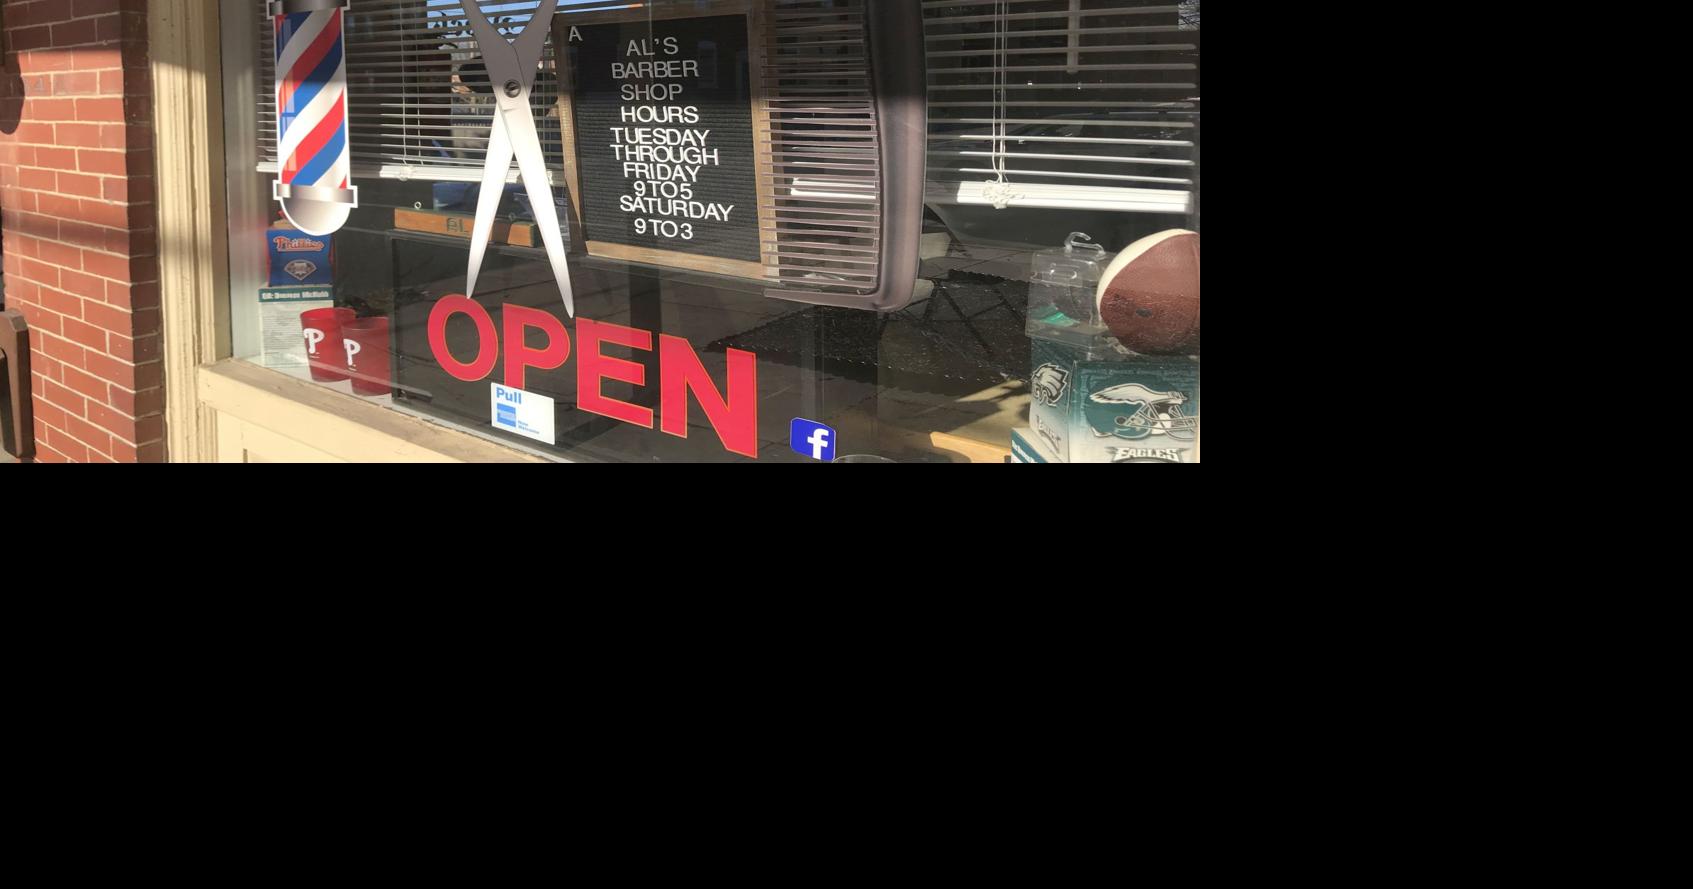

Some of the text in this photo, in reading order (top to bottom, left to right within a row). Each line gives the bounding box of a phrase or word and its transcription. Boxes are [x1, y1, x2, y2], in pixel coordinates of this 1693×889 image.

[568, 25, 583, 42] A
[626, 37, 679, 57] AL'S
[611, 60, 699, 79] BARBER
[620, 83, 684, 101] SHOP
[621, 106, 699, 124] HOURS
[610, 127, 710, 147] TUESDAY
[610, 144, 720, 166] THROUGH
[623, 162, 701, 183] FRIDAY
[633, 180, 693, 200] 9 TO 5
[620, 195, 734, 222] SATURDAY
[634, 218, 694, 240] 9 TO 3
[427, 293, 758, 458] OPEN
[496, 386, 522, 405] Pull
[1113, 447, 1180, 462] EAGLES
